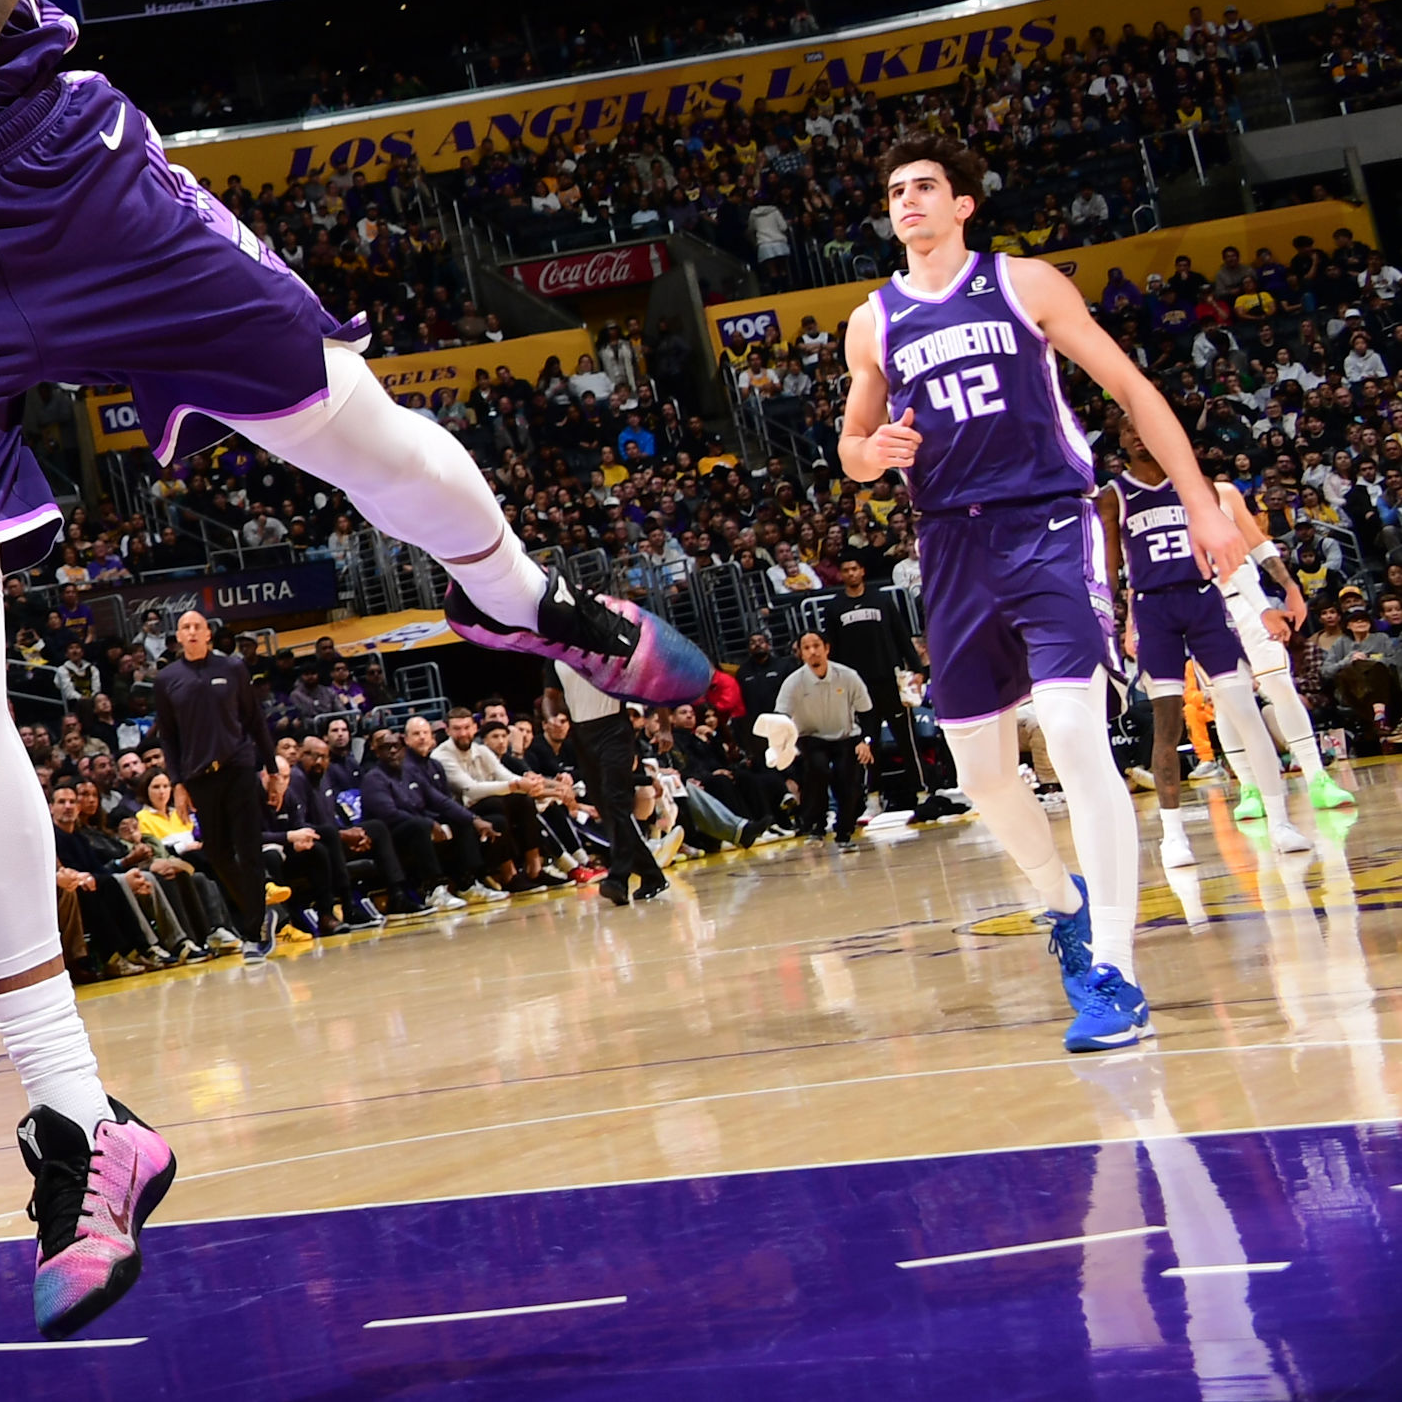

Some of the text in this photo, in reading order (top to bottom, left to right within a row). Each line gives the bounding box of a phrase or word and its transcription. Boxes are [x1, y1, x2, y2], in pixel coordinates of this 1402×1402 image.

[289, 13, 1059, 186] LOS ANGELES LAKERS
[538, 243, 632, 297] Coca-Cola
[892, 319, 1018, 384] SACRAMENTO
[105, 405, 140, 429] 10
[925, 362, 1008, 424] 42
[1145, 529, 1193, 563] 23
[217, 578, 295, 608] ULTRA
